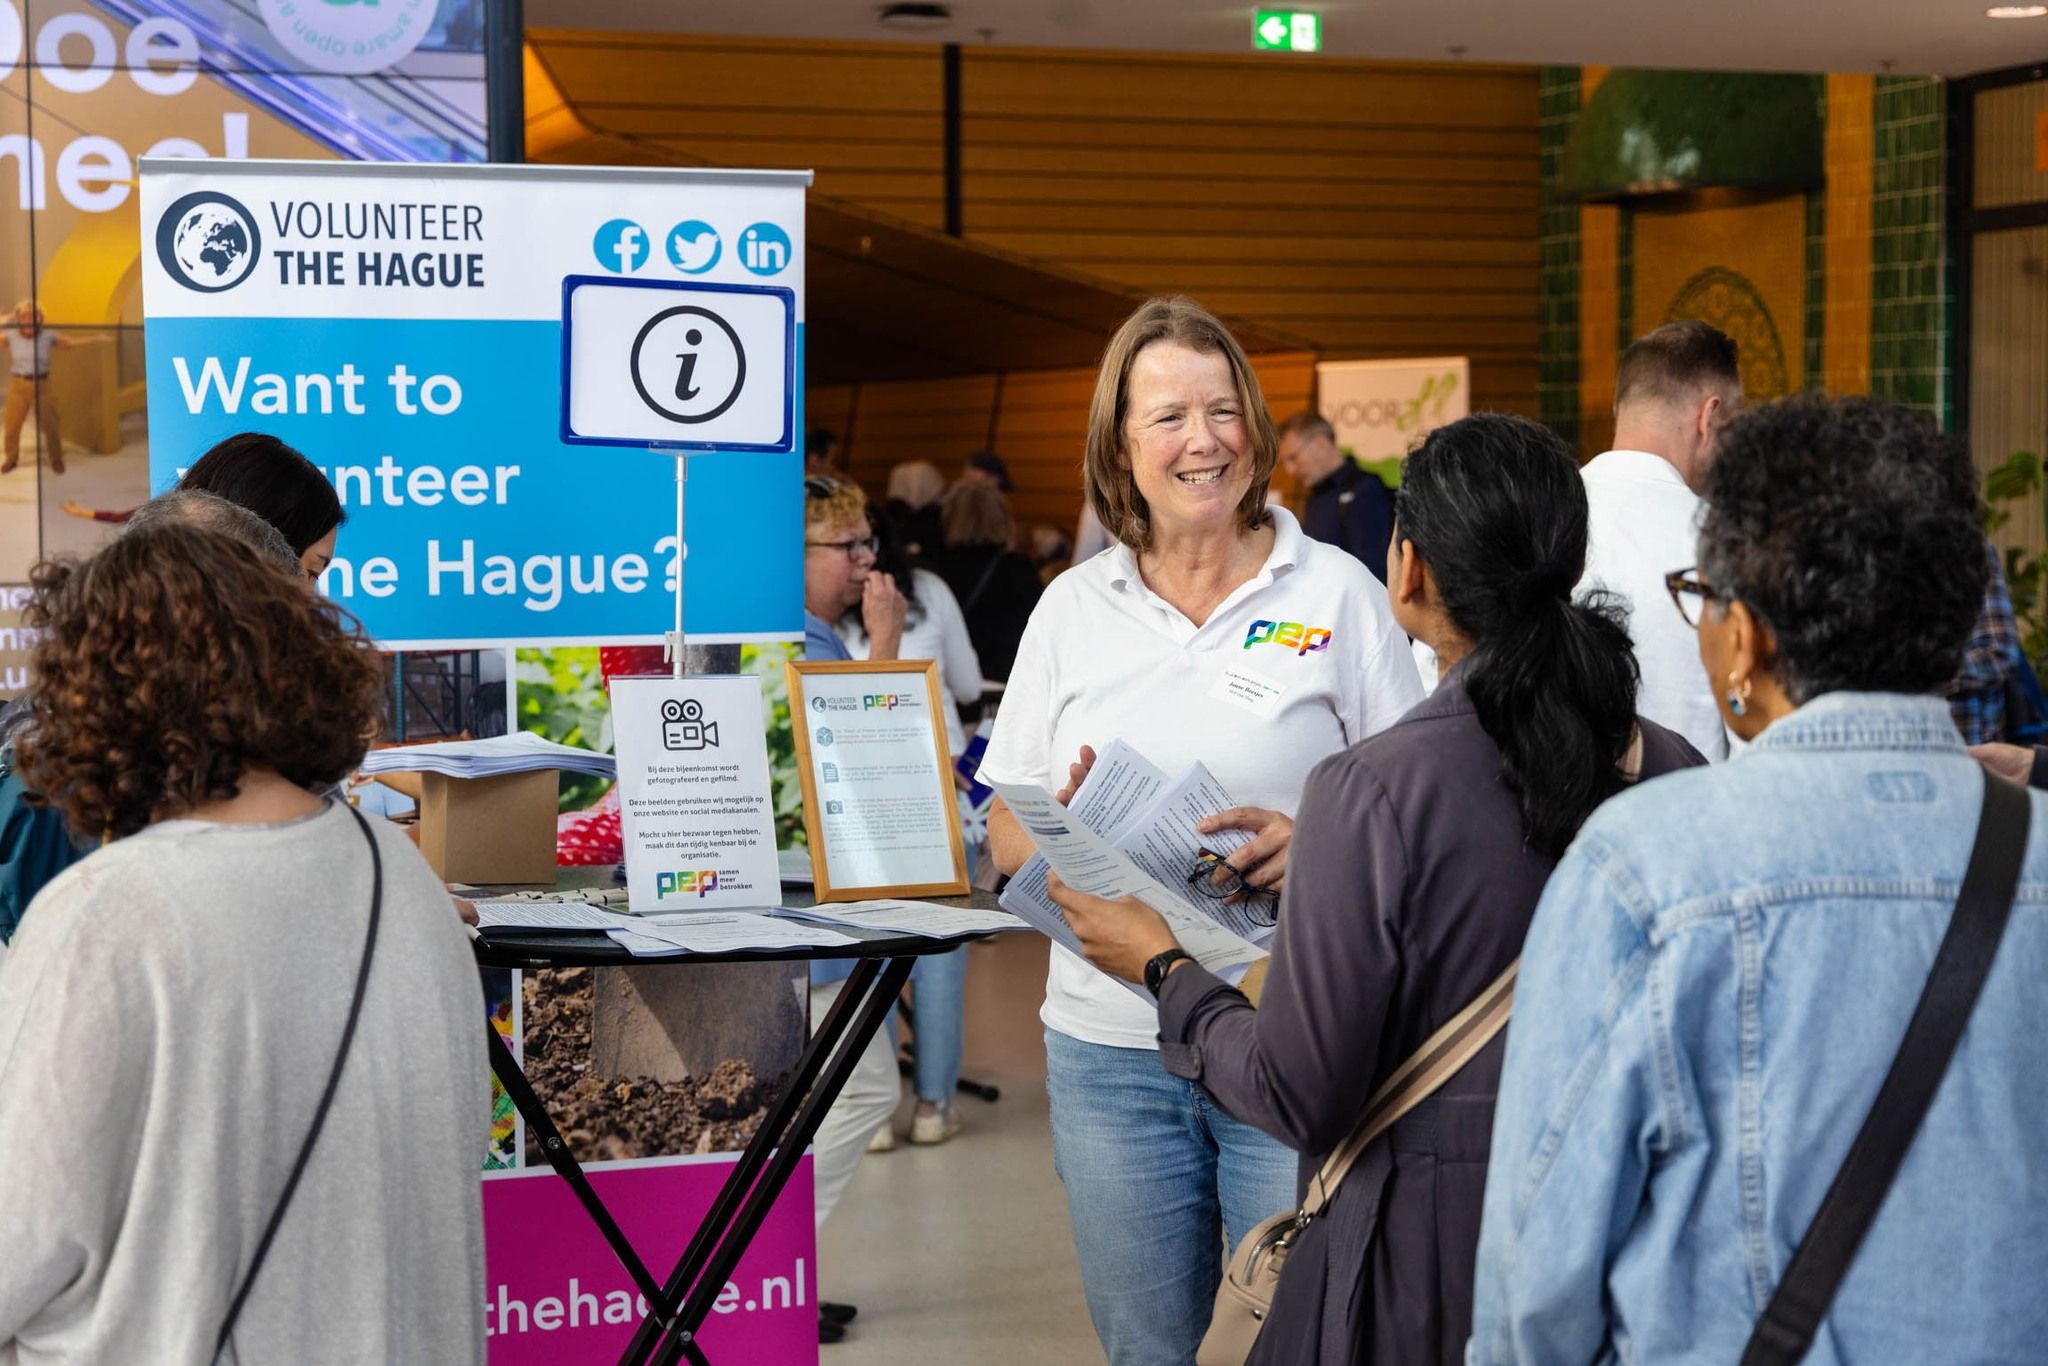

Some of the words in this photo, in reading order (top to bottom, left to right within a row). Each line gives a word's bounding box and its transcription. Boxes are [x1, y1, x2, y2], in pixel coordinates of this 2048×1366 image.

[270, 200, 484, 241] VOLUNTEER
[273, 250, 345, 285] THE
[358, 251, 484, 288] HAGUE
[172, 356, 366, 415] Want
[388, 364, 463, 415] to
[427, 535, 688, 612] Hague?
[1243, 619, 1332, 656] pep
[863, 694, 899, 711] pep
[647, 765, 658, 774] Bij
[658, 765, 675, 773] deze
[675, 764, 718, 774] bijeenkomst
[647, 775, 700, 785] gefotografeerd
[710, 774, 739, 784] gefilmd.
[647, 797, 676, 806] beelden
[677, 797, 712, 806] gebruiken
[713, 796, 724, 805] wij
[724, 795, 754, 805] mogelijk
[754, 796, 764, 804] op
[690, 807, 710, 815] social
[639, 831, 660, 839] Mocht
[667, 830, 681, 838] hier
[712, 829, 732, 838] tegen
[732, 828, 761, 836] hebben,
[665, 841, 675, 849] dit
[690, 840, 709, 849] tijdig
[737, 839, 748, 847] bij
[748, 838, 757, 846] de
[680, 851, 720, 861] organisatie.
[656, 870, 718, 900] pep
